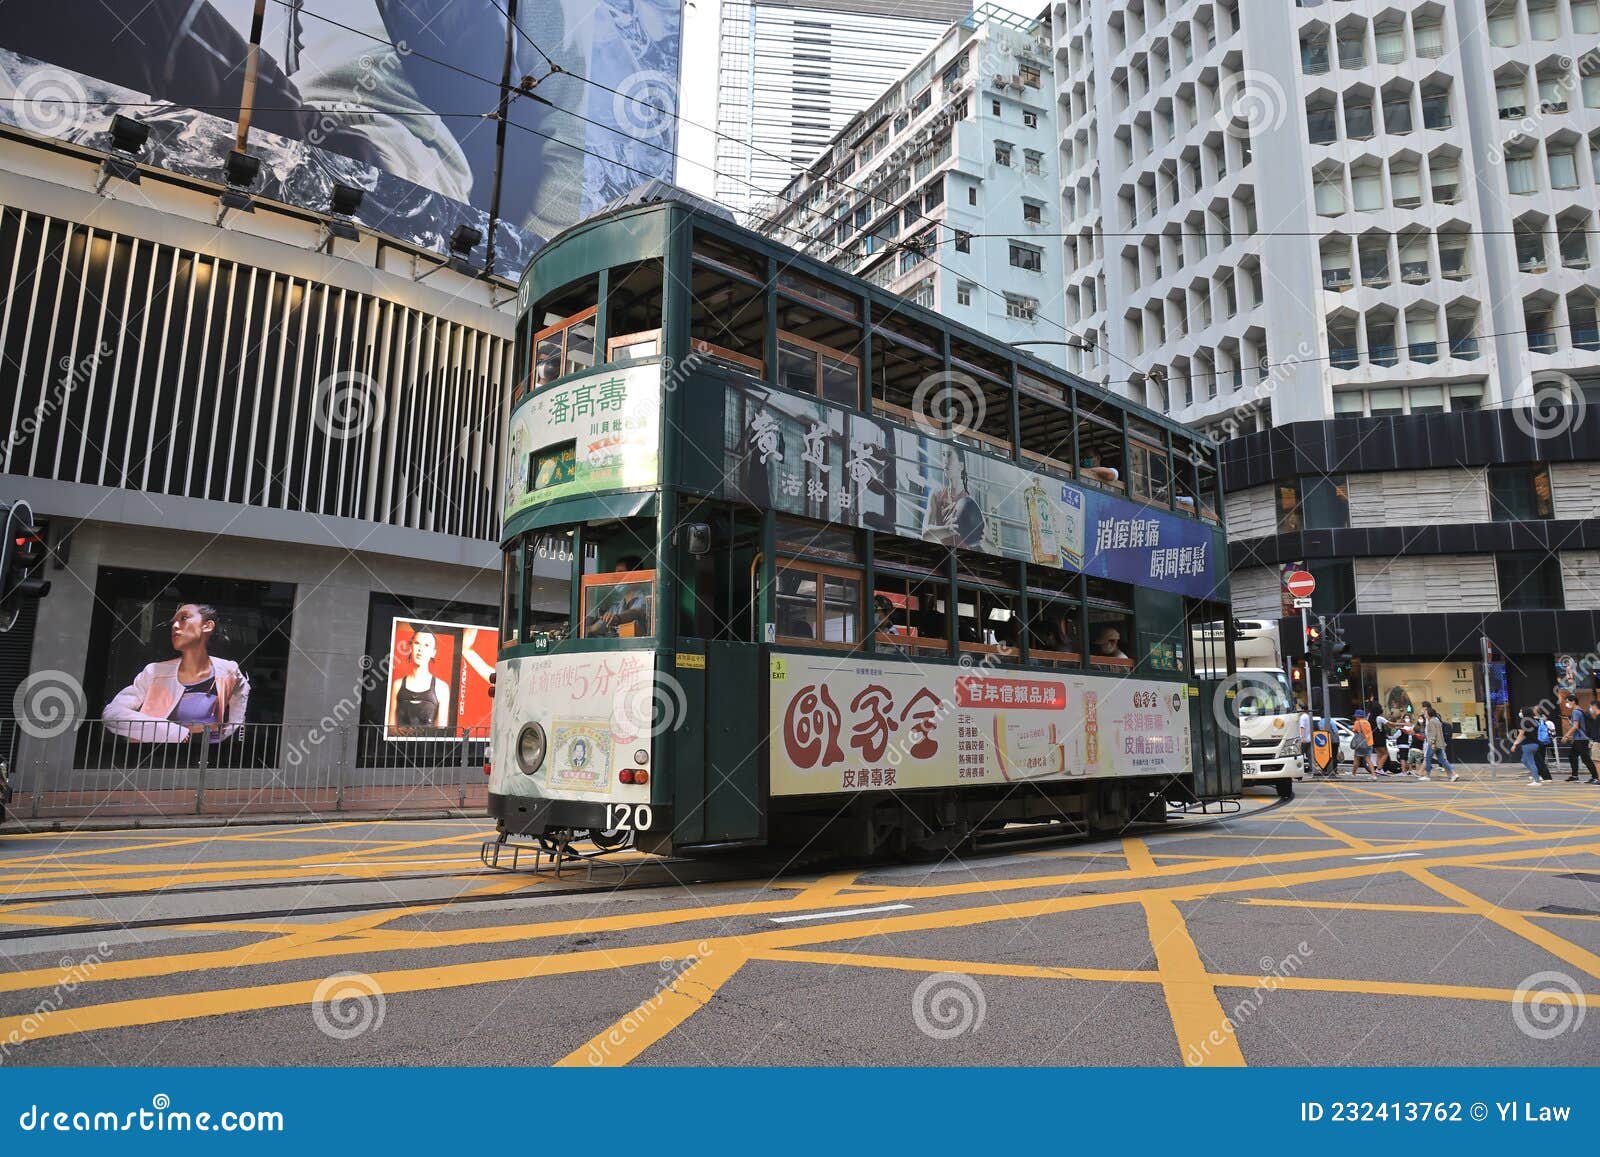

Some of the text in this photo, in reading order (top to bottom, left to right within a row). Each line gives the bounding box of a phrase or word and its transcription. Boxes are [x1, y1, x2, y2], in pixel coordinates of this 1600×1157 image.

[1150, 541, 1208, 580] 瞬間輕鬆
[968, 683, 1057, 704] 百年信賴品牌
[842, 768, 897, 788] 皮膚專家
[606, 804, 653, 831] 120
